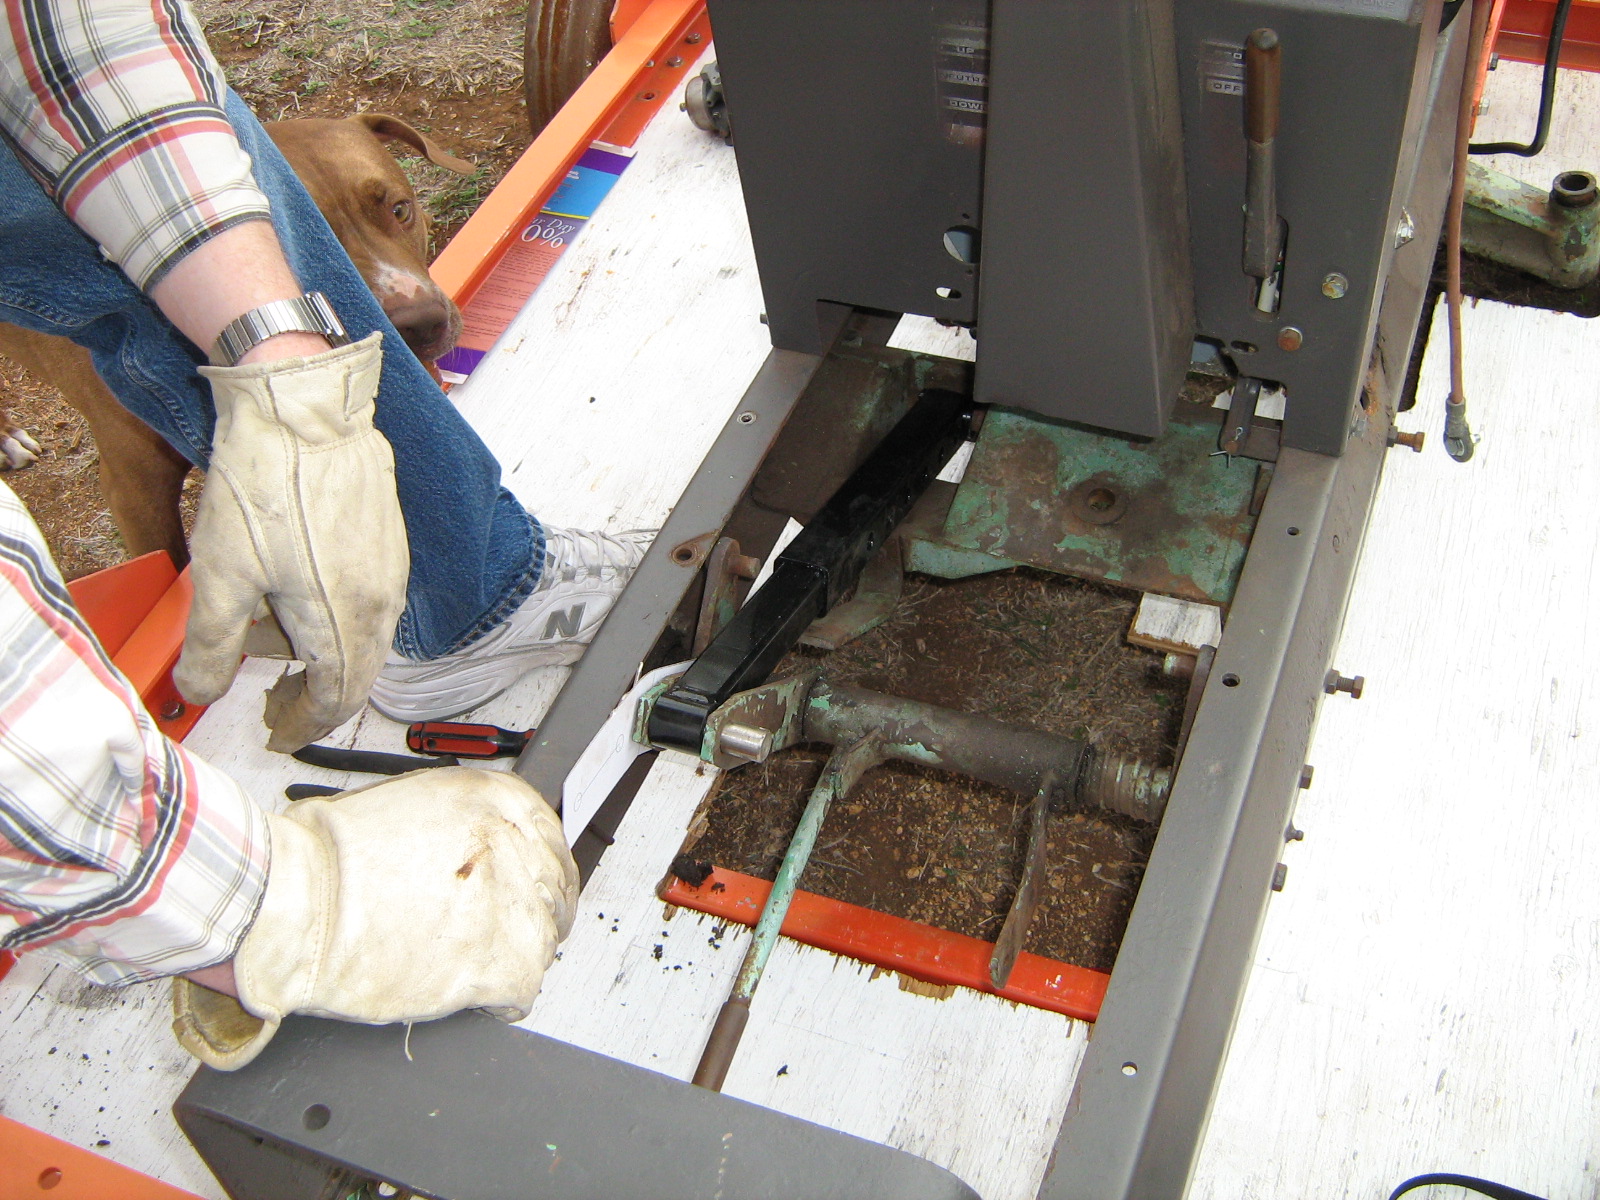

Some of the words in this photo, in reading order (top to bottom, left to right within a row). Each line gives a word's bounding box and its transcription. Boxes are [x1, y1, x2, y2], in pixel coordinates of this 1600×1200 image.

[956, 46, 975, 54] UP
[1213, 83, 1242, 91] OFF
[547, 218, 576, 233] Day
[541, 602, 586, 639] N
